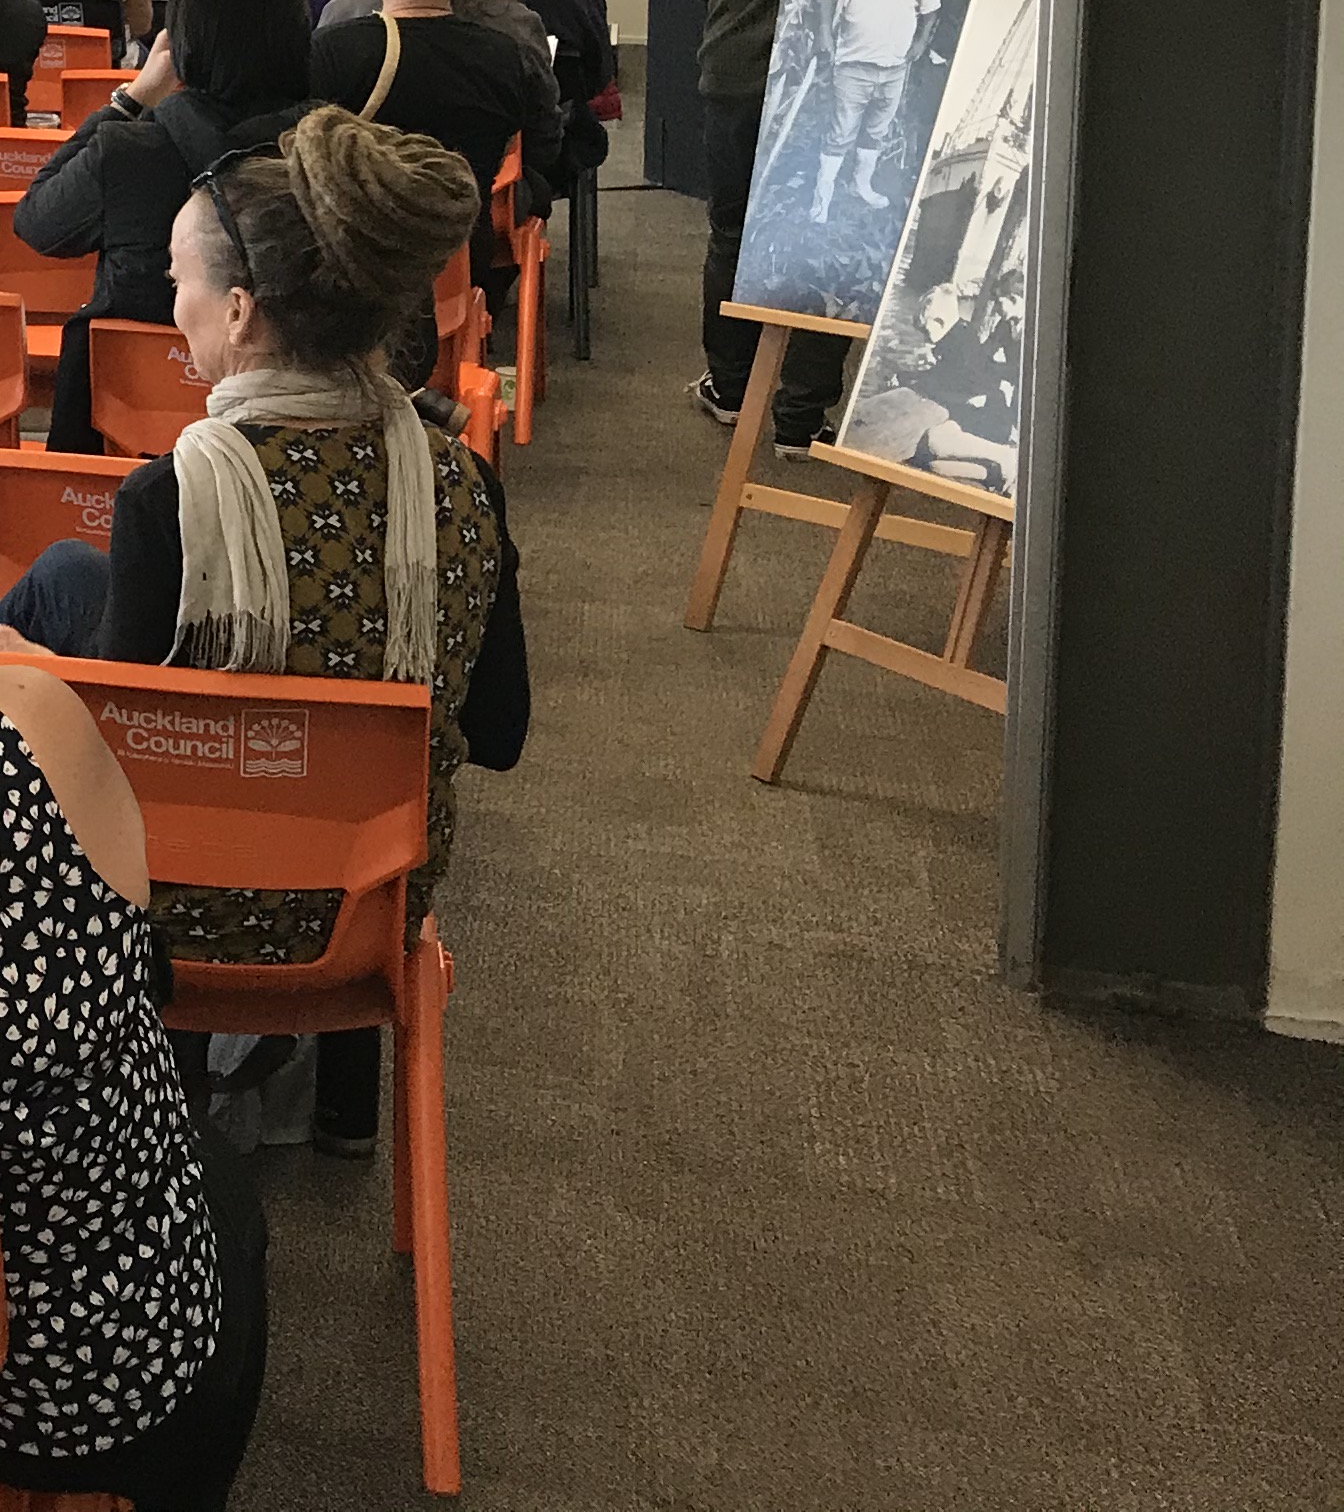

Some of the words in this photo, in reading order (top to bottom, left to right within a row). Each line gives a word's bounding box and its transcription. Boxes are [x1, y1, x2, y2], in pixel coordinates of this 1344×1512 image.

[2, 161, 43, 174] Coun
[61, 487, 114, 508] Auck
[100, 701, 235, 737] Auckland
[126, 728, 234, 759] Council
